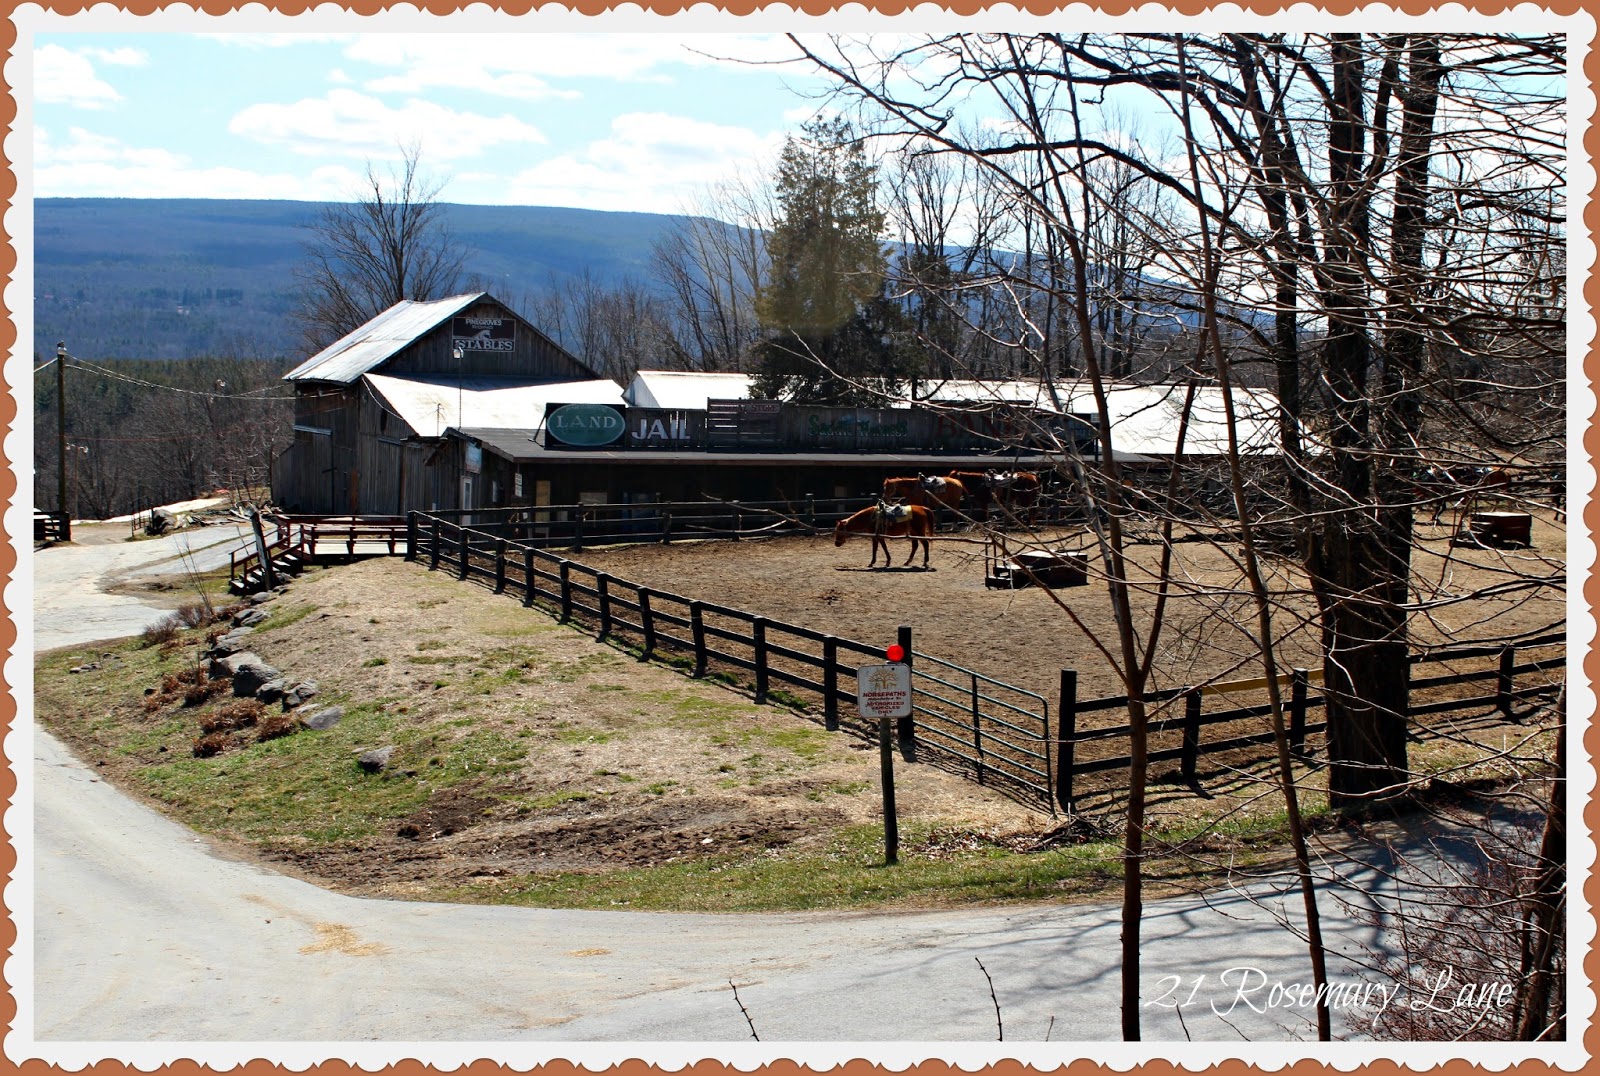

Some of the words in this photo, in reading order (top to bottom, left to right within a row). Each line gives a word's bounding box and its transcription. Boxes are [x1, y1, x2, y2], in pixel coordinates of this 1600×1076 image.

[458, 339, 513, 351] STABLES
[556, 415, 617, 429] LAND
[631, 418, 691, 440] JAIL
